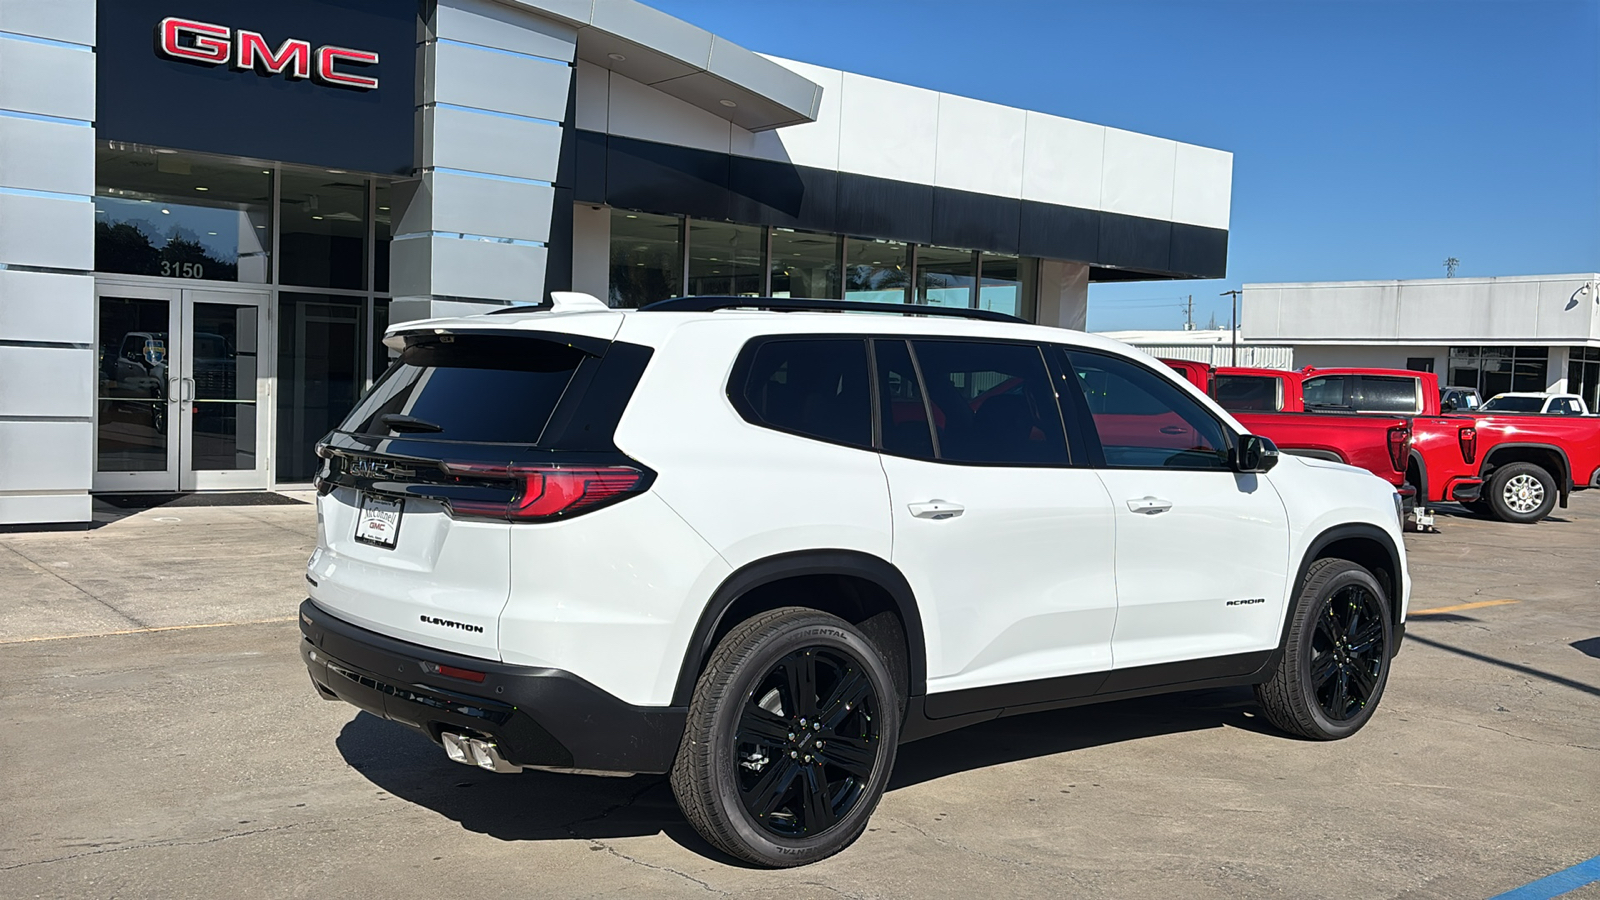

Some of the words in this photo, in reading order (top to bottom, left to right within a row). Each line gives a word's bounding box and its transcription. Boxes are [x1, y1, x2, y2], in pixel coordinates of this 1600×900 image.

[159, 16, 380, 90] GMC
[161, 260, 203, 279] 3150
[369, 521, 385, 531] GMC
[1226, 598, 1265, 607] ACADIA
[420, 615, 484, 634] ELEVATION
[785, 628, 848, 642] NTINENTAL
